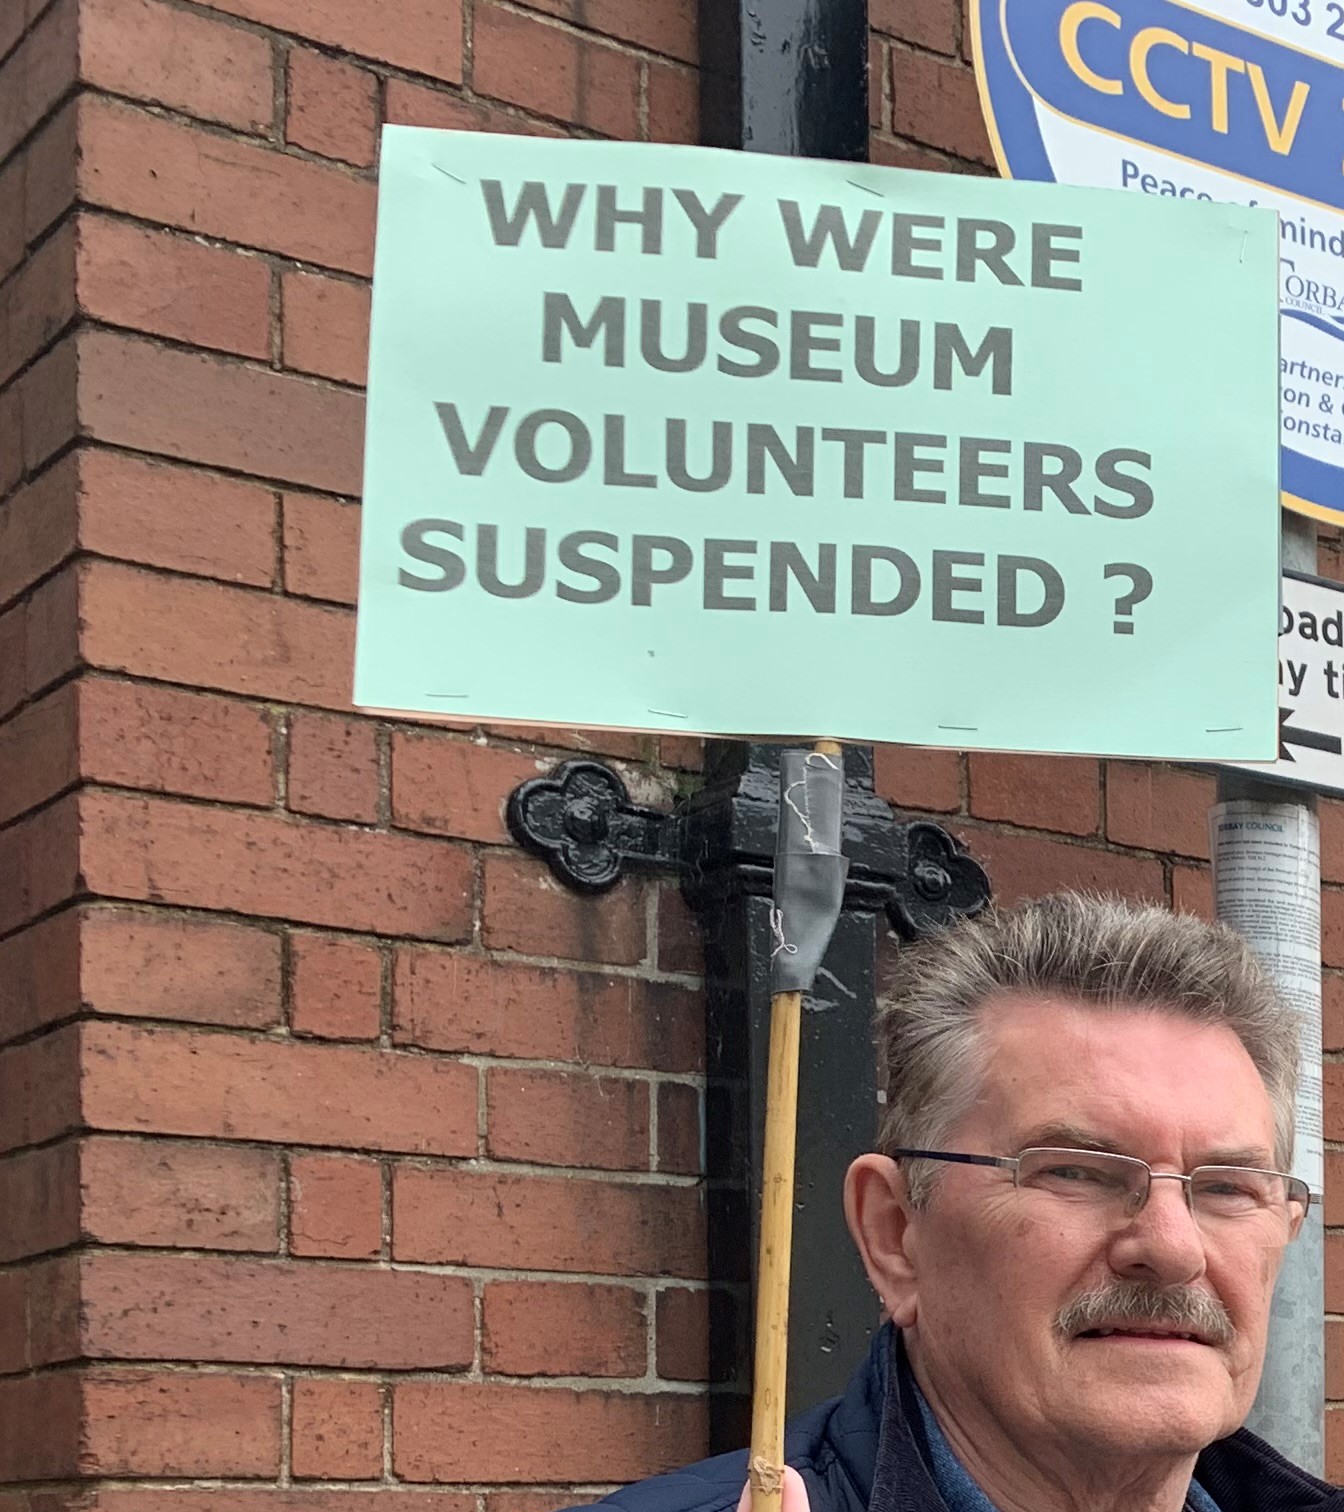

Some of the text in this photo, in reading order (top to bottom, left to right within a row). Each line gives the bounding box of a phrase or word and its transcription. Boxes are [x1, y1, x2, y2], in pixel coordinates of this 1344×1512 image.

[1059, 2, 1310, 156] CCTV
[481, 178, 1085, 293] WHY WERE
[541, 292, 1014, 397] MUSEUM
[434, 401, 1155, 520] VOLUNTEERS
[1318, 393, 1334, 414] &
[397, 518, 1154, 635] SUSPENDED ?
